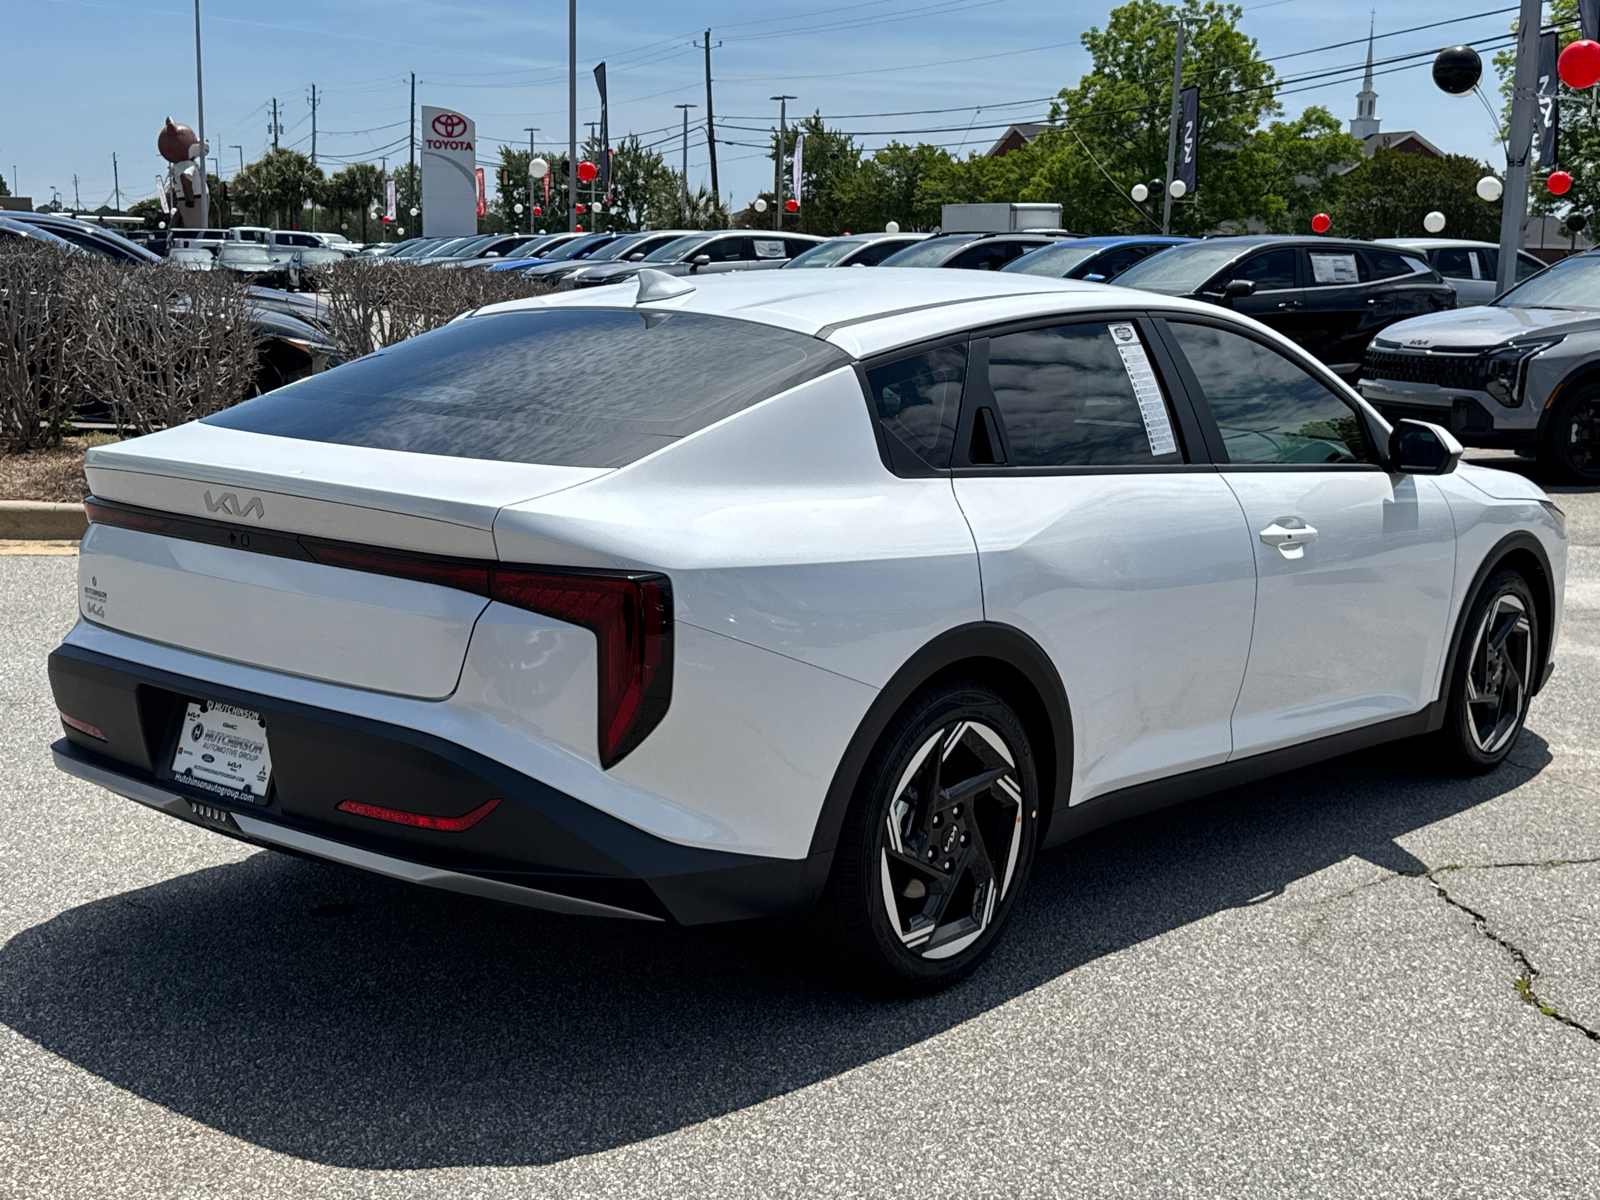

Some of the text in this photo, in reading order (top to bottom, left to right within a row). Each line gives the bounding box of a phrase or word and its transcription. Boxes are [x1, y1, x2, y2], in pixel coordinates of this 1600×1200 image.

[425, 139, 473, 152] TOYOTA
[203, 489, 265, 519] KIA
[87, 602, 104, 618] K4
[187, 711, 200, 719] KIA
[214, 701, 261, 721] HUTCHINSON
[222, 722, 238, 730] GMC
[204, 729, 264, 754] HUTCHINSON
[202, 742, 237, 757] AUTOMOTIVE
[238, 751, 259, 762] GROUP
[227, 761, 242, 770] KIA
[174, 773, 255, 803] Hutchinsonautogroup.com
